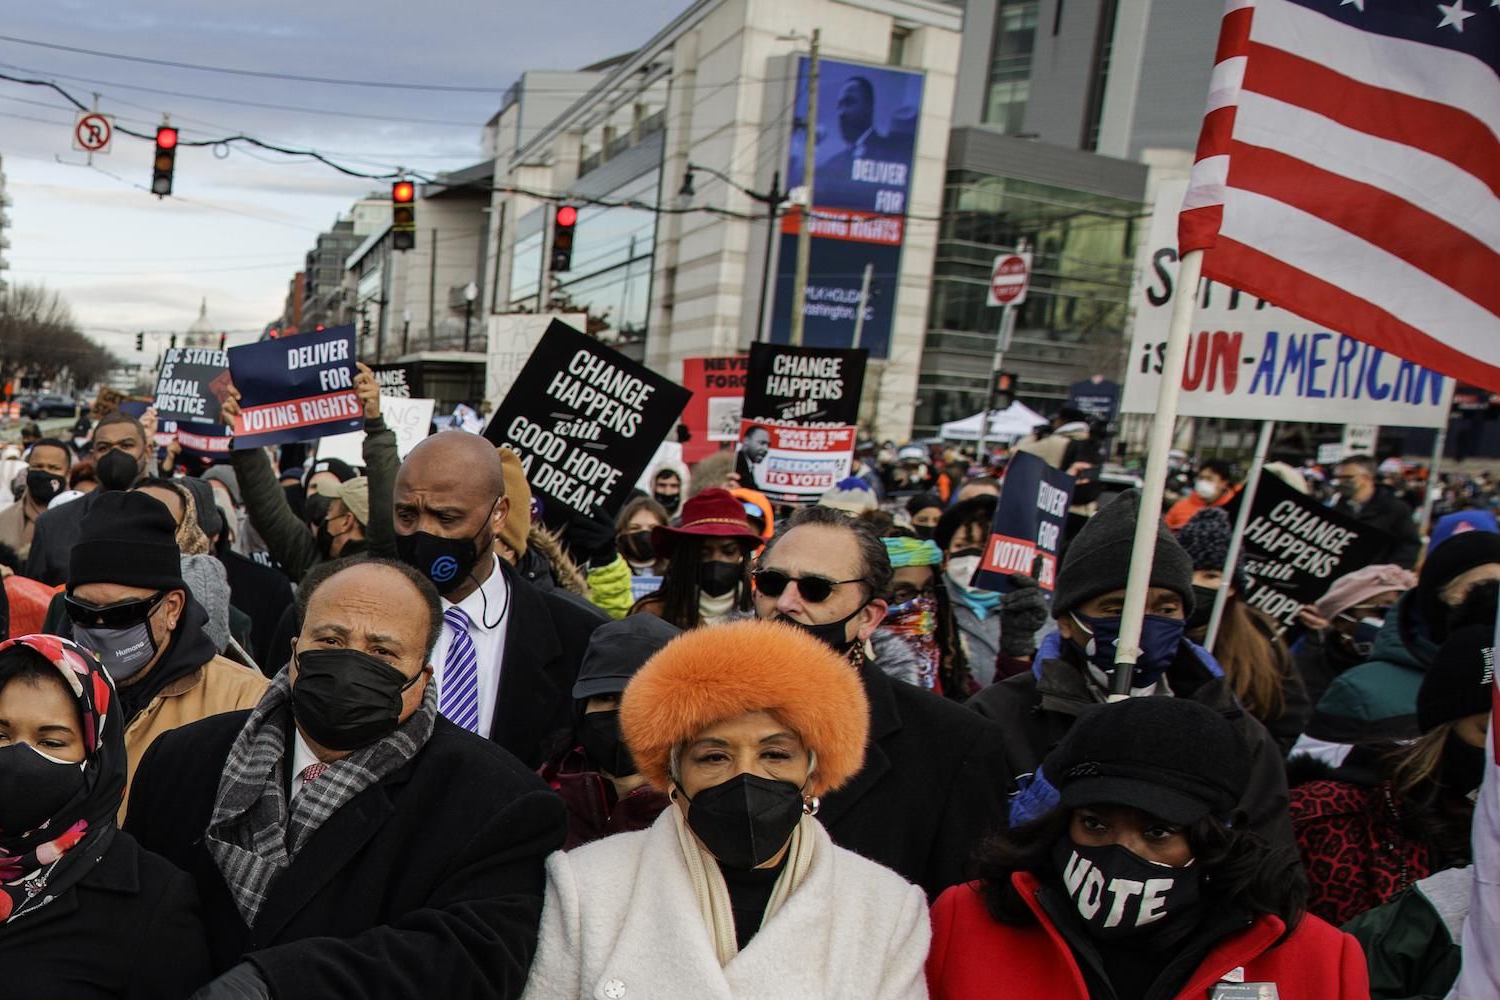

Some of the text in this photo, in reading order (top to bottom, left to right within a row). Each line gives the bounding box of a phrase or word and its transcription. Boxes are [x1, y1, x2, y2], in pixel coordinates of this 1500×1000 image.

[852, 158, 908, 186] DELIVER
[875, 190, 905, 213] FOR
[166, 348, 230, 368] DC STATEH
[287, 338, 349, 370] DELIVER
[704, 358, 750, 372] NEVE
[773, 354, 843, 378] CHANGE
[161, 363, 175, 379] IS
[320, 368, 352, 391] FOR
[568, 350, 656, 412] CHANGE
[1181, 331, 1446, 406] UN-AMERICAN
[157, 379, 200, 397] RACIAL
[765, 375, 844, 400] HAPPENS
[153, 394, 206, 415] JUSTICE
[242, 405, 299, 432] VOTING
[301, 393, 360, 423] RIGHTS
[546, 371, 643, 439] HAPPENS
[781, 399, 818, 420] with
[553, 417, 602, 442] with
[507, 416, 623, 496] GOOD HOPE
[768, 472, 831, 487] TO VOTE
[1038, 520, 1060, 551] FOR
[1269, 500, 1358, 555] CHANGE
[992, 540, 1037, 573] VOTIN
[1243, 516, 1340, 578] HAPPENS
[1244, 559, 1296, 581] with
[115, 641, 145, 657] Humana
[1062, 849, 1175, 928] VOTE
